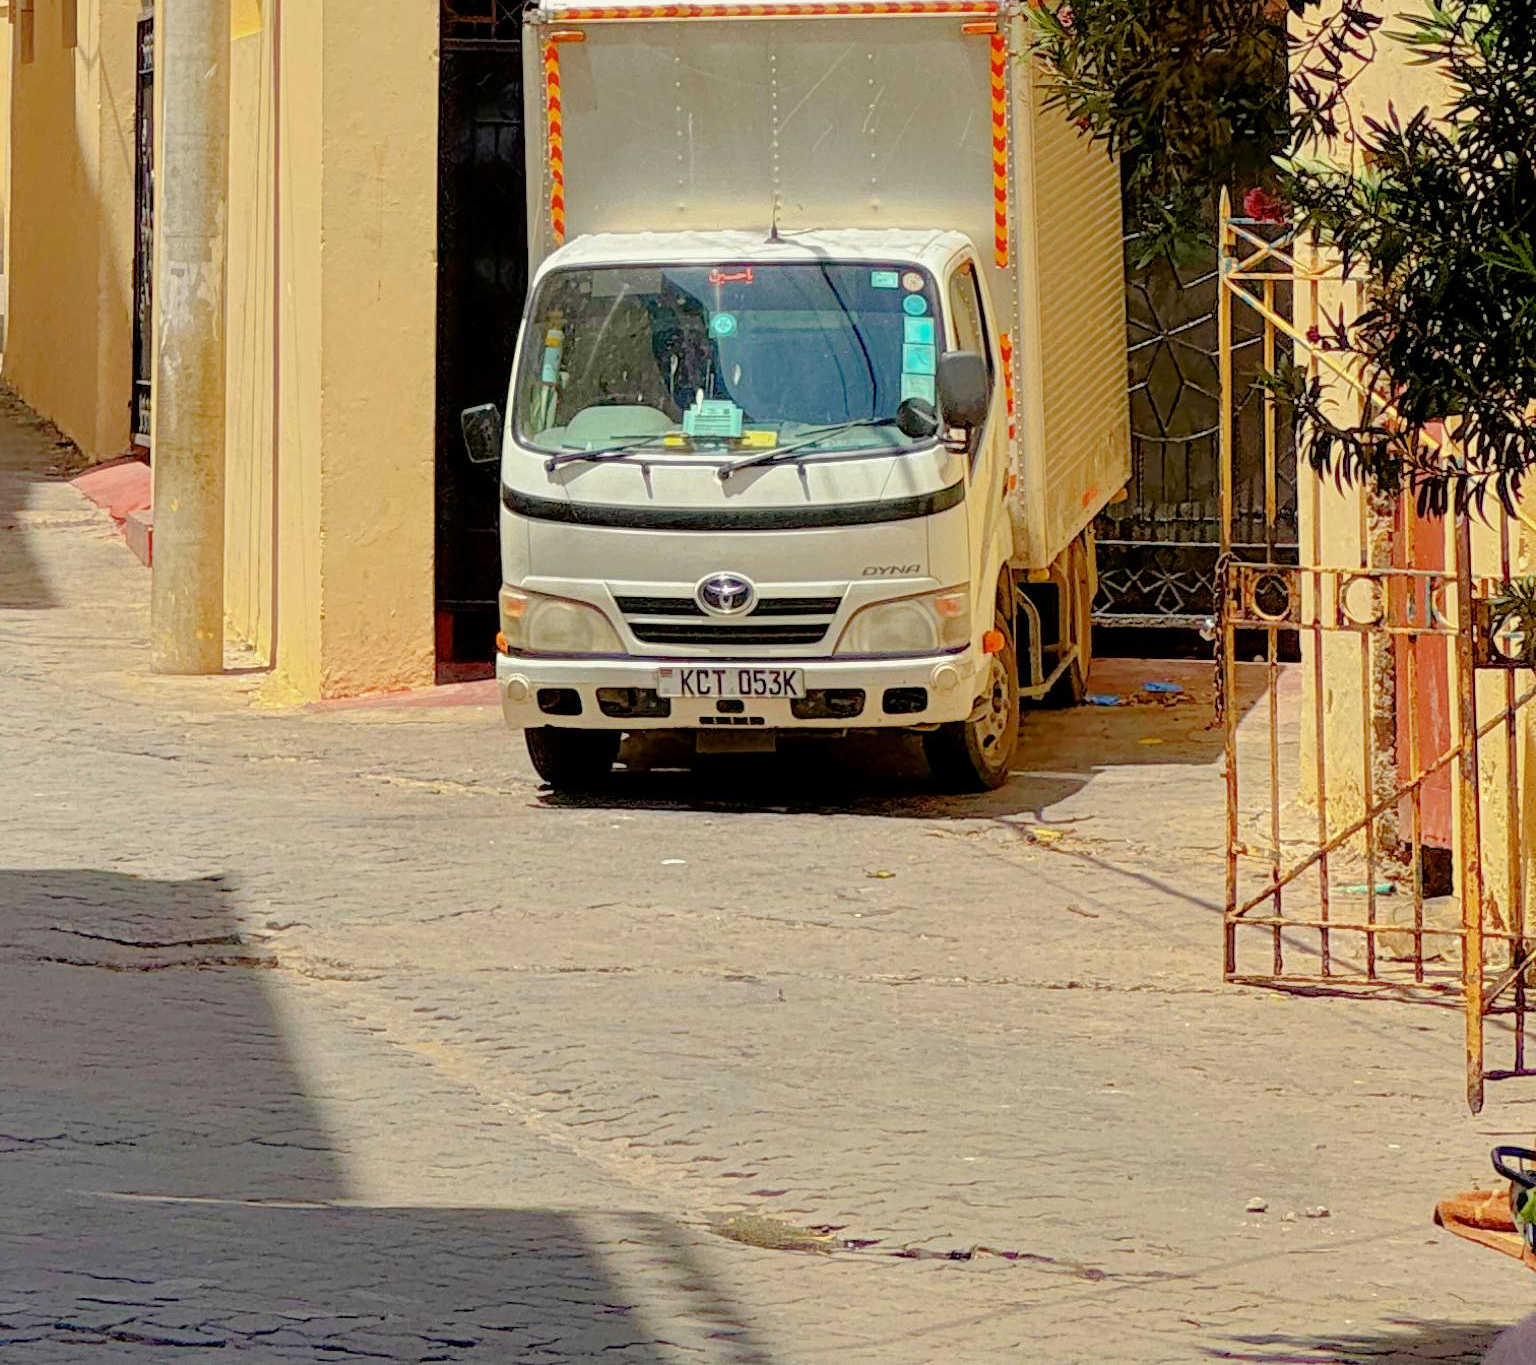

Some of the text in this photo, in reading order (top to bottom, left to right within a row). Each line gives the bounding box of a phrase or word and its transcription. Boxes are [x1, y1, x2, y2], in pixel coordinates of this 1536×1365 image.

[862, 564, 920, 576] DYNA
[680, 670, 798, 696] KCT 053K
